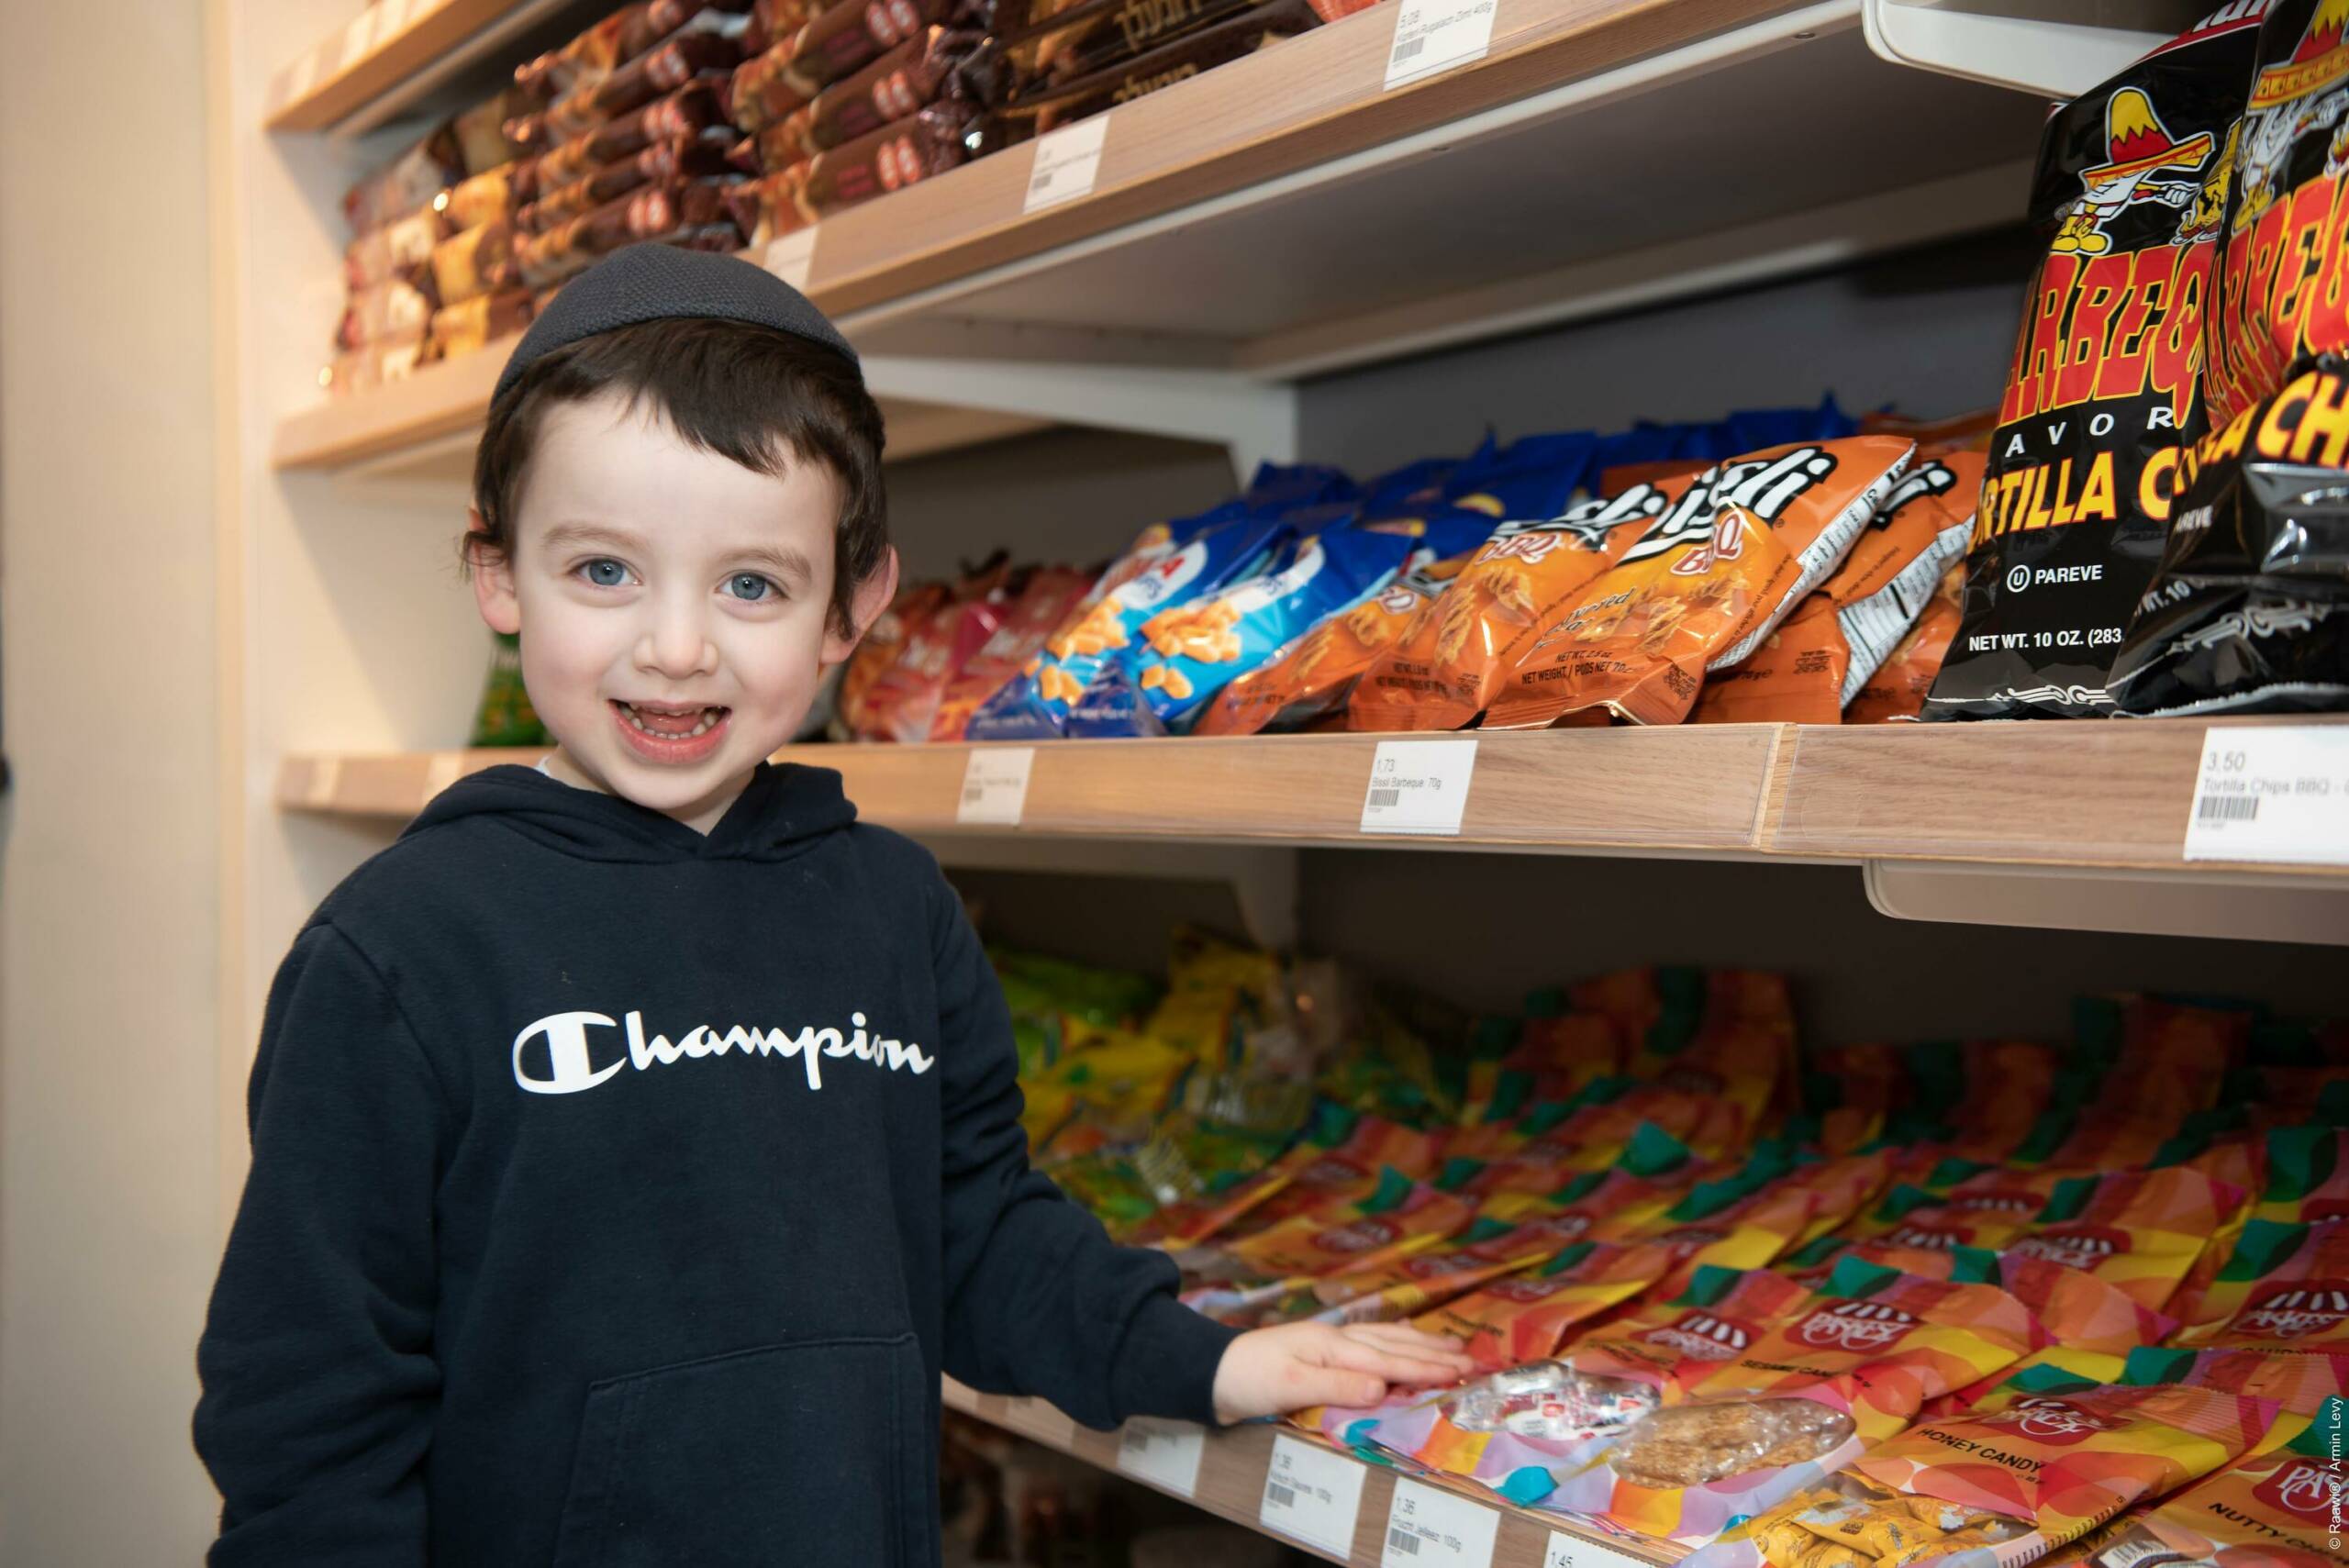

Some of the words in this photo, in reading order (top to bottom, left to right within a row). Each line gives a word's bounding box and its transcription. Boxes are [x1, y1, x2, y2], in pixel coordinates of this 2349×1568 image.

[2035, 564, 2103, 584] PAREVE
[1969, 635, 1999, 651] NET
[2001, 633, 2029, 649] WT.
[2033, 632, 2052, 647] 10
[2056, 630, 2083, 646] OZ.
[1522, 671, 1538, 684] NET
[1539, 665, 1566, 682] WEIGHT
[1596, 661, 1611, 674] NET
[2204, 777, 2245, 793] Tortilla
[2250, 778, 2290, 795] Chips
[512, 1010, 934, 1094] Champion
[1916, 1428, 1982, 1451] HONEY
[1978, 1448, 2046, 1473] CANDY
[2209, 1502, 2286, 1538] NUTTY
